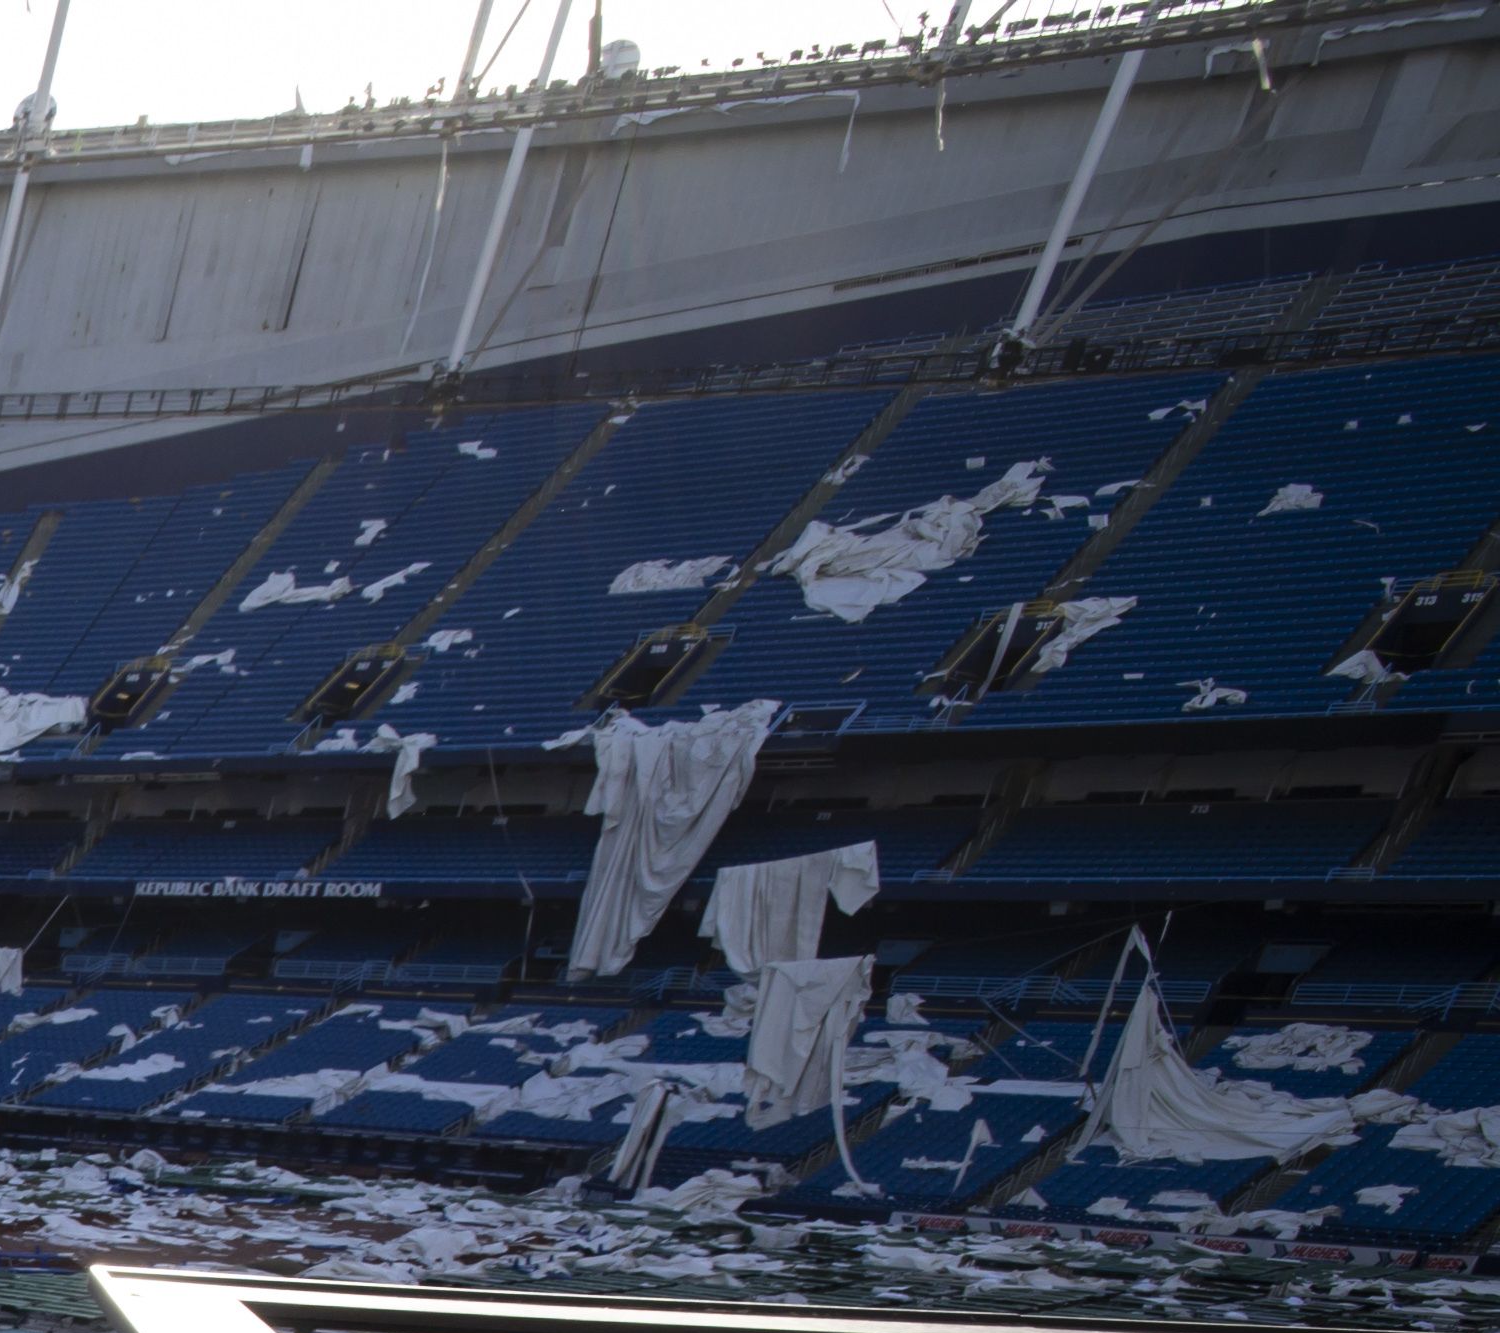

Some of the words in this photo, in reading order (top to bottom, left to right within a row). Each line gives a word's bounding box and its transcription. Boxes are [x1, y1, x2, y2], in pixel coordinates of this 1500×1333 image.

[1414, 594, 1437, 607] 313
[135, 882, 211, 897] REPUBLIC
[211, 881, 261, 897] BANK
[263, 882, 321, 897] DRAFT
[323, 882, 382, 897] ROOM
